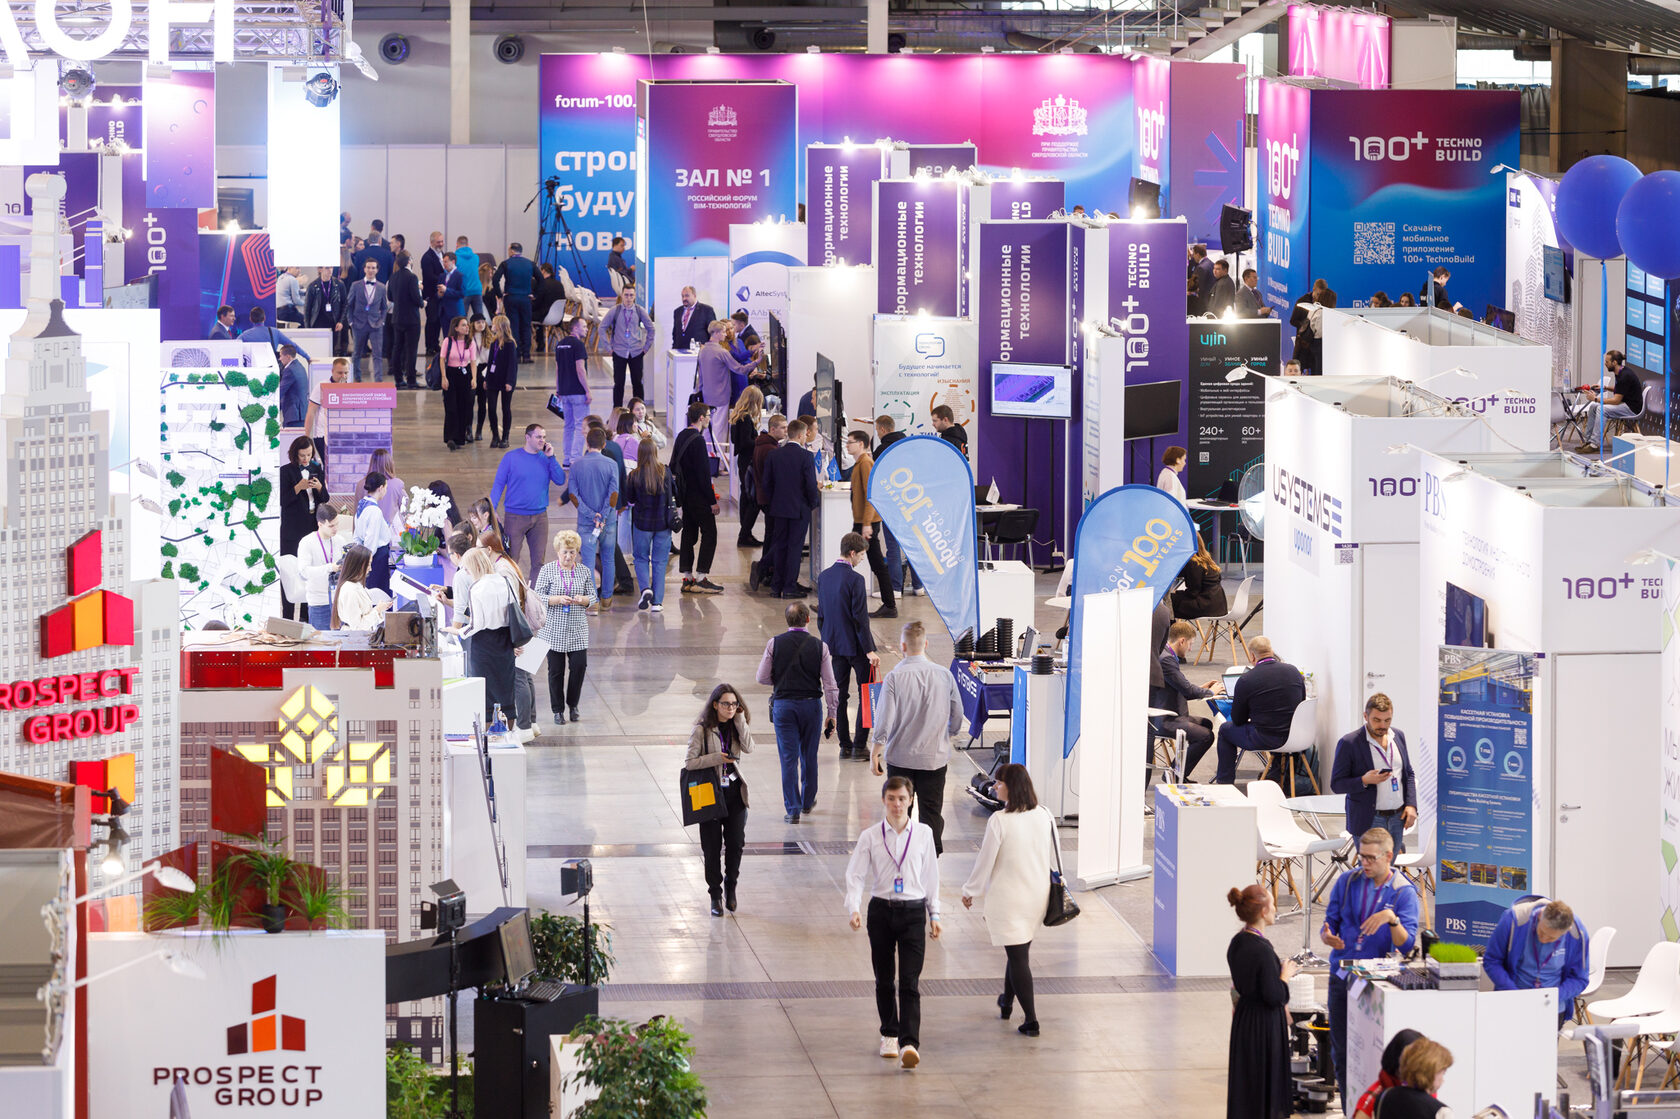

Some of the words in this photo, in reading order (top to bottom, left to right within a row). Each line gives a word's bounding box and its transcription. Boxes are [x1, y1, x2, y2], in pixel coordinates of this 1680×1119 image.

[1349, 131, 1429, 161] 100+
[1436, 138, 1482, 148] TECHNO
[1436, 150, 1482, 162] BUILD
[676, 168, 719, 186] ЗАЛ
[726, 168, 752, 186] №
[760, 168, 770, 186] 1
[556, 184, 634, 218] буду
[840, 165, 848, 240] технологии
[1402, 224, 1442, 232] Скачайте
[914, 201, 924, 285] технологии
[1402, 235, 1450, 243] мобильное
[1268, 231, 1290, 269] BUILD
[1402, 246, 1454, 254] приложение
[1403, 256, 1424, 264] 100+
[1426, 255, 1475, 264] TechnoBuild
[1128, 243, 1137, 288] TECHNO
[1139, 243, 1150, 288] BUILD
[1020, 245, 1031, 340] технологии
[1200, 332, 1226, 346] ujin
[1504, 406, 1536, 414] BUILD
[1200, 426, 1224, 436] 240+
[1242, 426, 1261, 436] 60+
[1368, 477, 1420, 496] 100
[1122, 518, 1172, 578] 100
[1155, 529, 1184, 560] YEARS
[1444, 654, 1461, 664] PBS
[25, 704, 140, 744] GROUP
[1446, 918, 1466, 930] PBS
[154, 1066, 322, 1086] PROSPECT
[215, 1088, 323, 1107] GROUP
